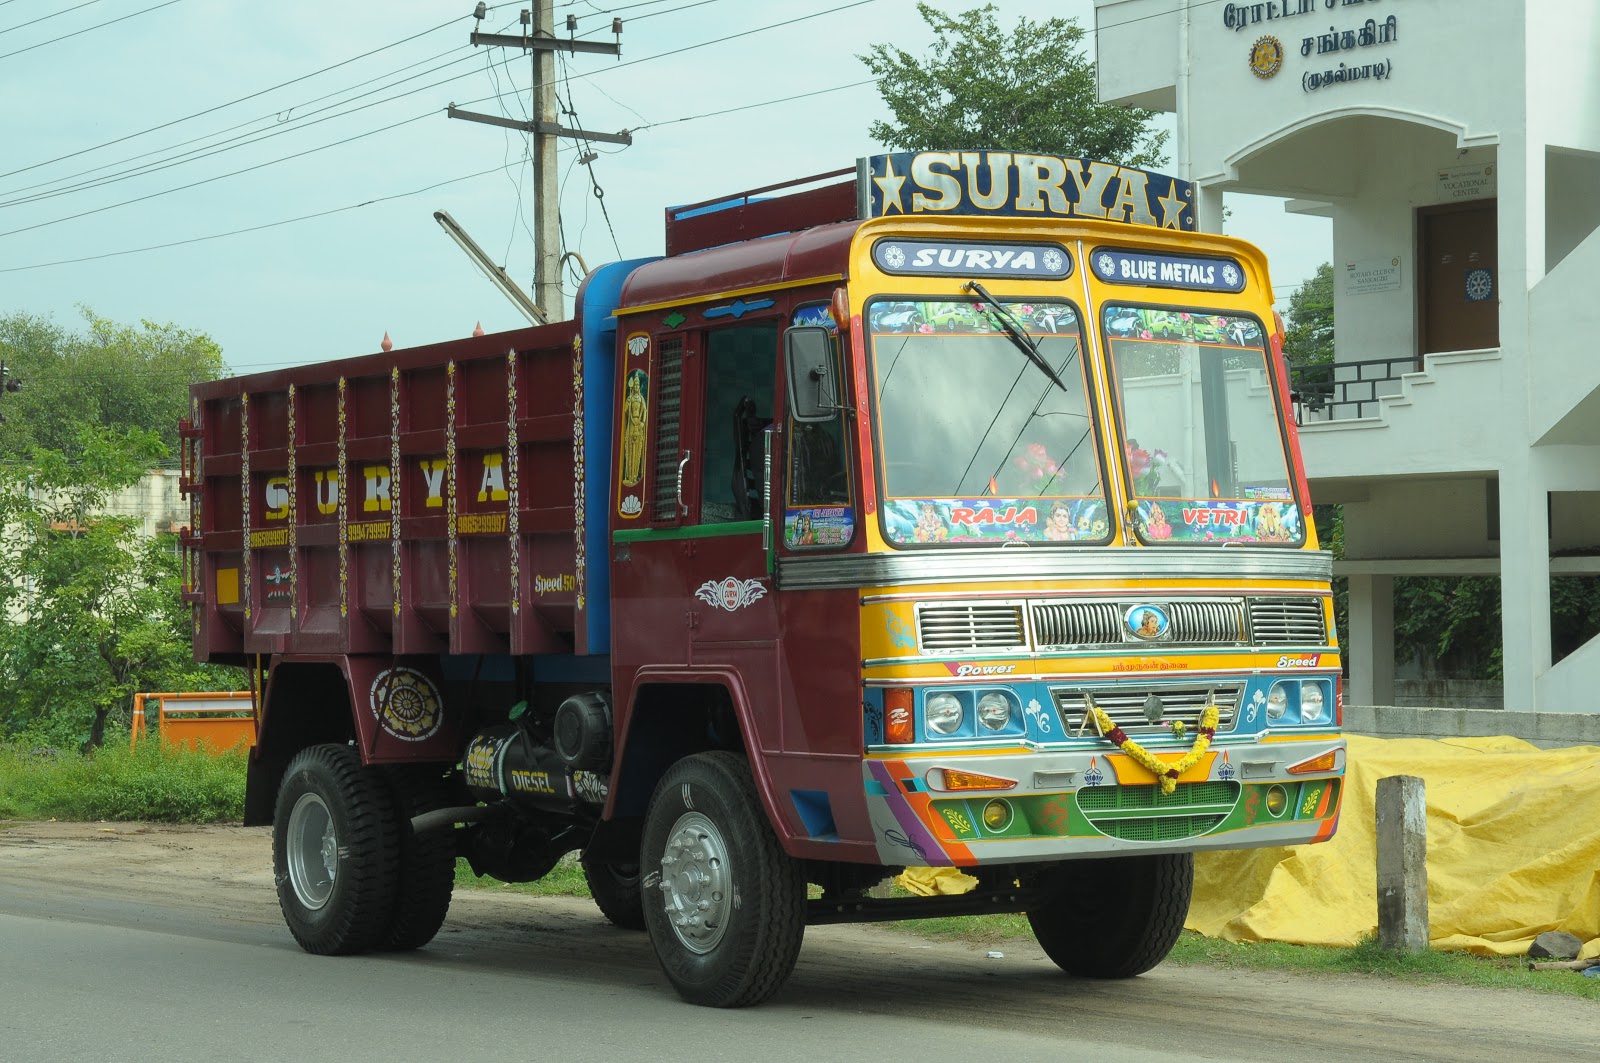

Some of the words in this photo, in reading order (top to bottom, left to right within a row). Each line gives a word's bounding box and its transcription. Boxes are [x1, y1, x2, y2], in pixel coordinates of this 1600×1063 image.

[1301, 15, 1397, 57] சங்ககிரி
[911, 150, 1158, 228] SURYA
[1443, 178, 1489, 190] VOCATIONAL
[1452, 187, 1480, 197] CENTER
[912, 248, 1037, 271] SURYA
[1120, 258, 1157, 280] BLUE
[1160, 262, 1216, 286] METALS
[265, 452, 509, 520] SURYA
[950, 507, 1037, 526] RAJA
[1182, 508, 1248, 526] VETRI
[535, 573, 562, 597] Speed
[563, 574, 576, 592] 50
[956, 664, 1016, 678] Power
[1276, 655, 1318, 668] Speed
[511, 770, 555, 793] DIESEL
